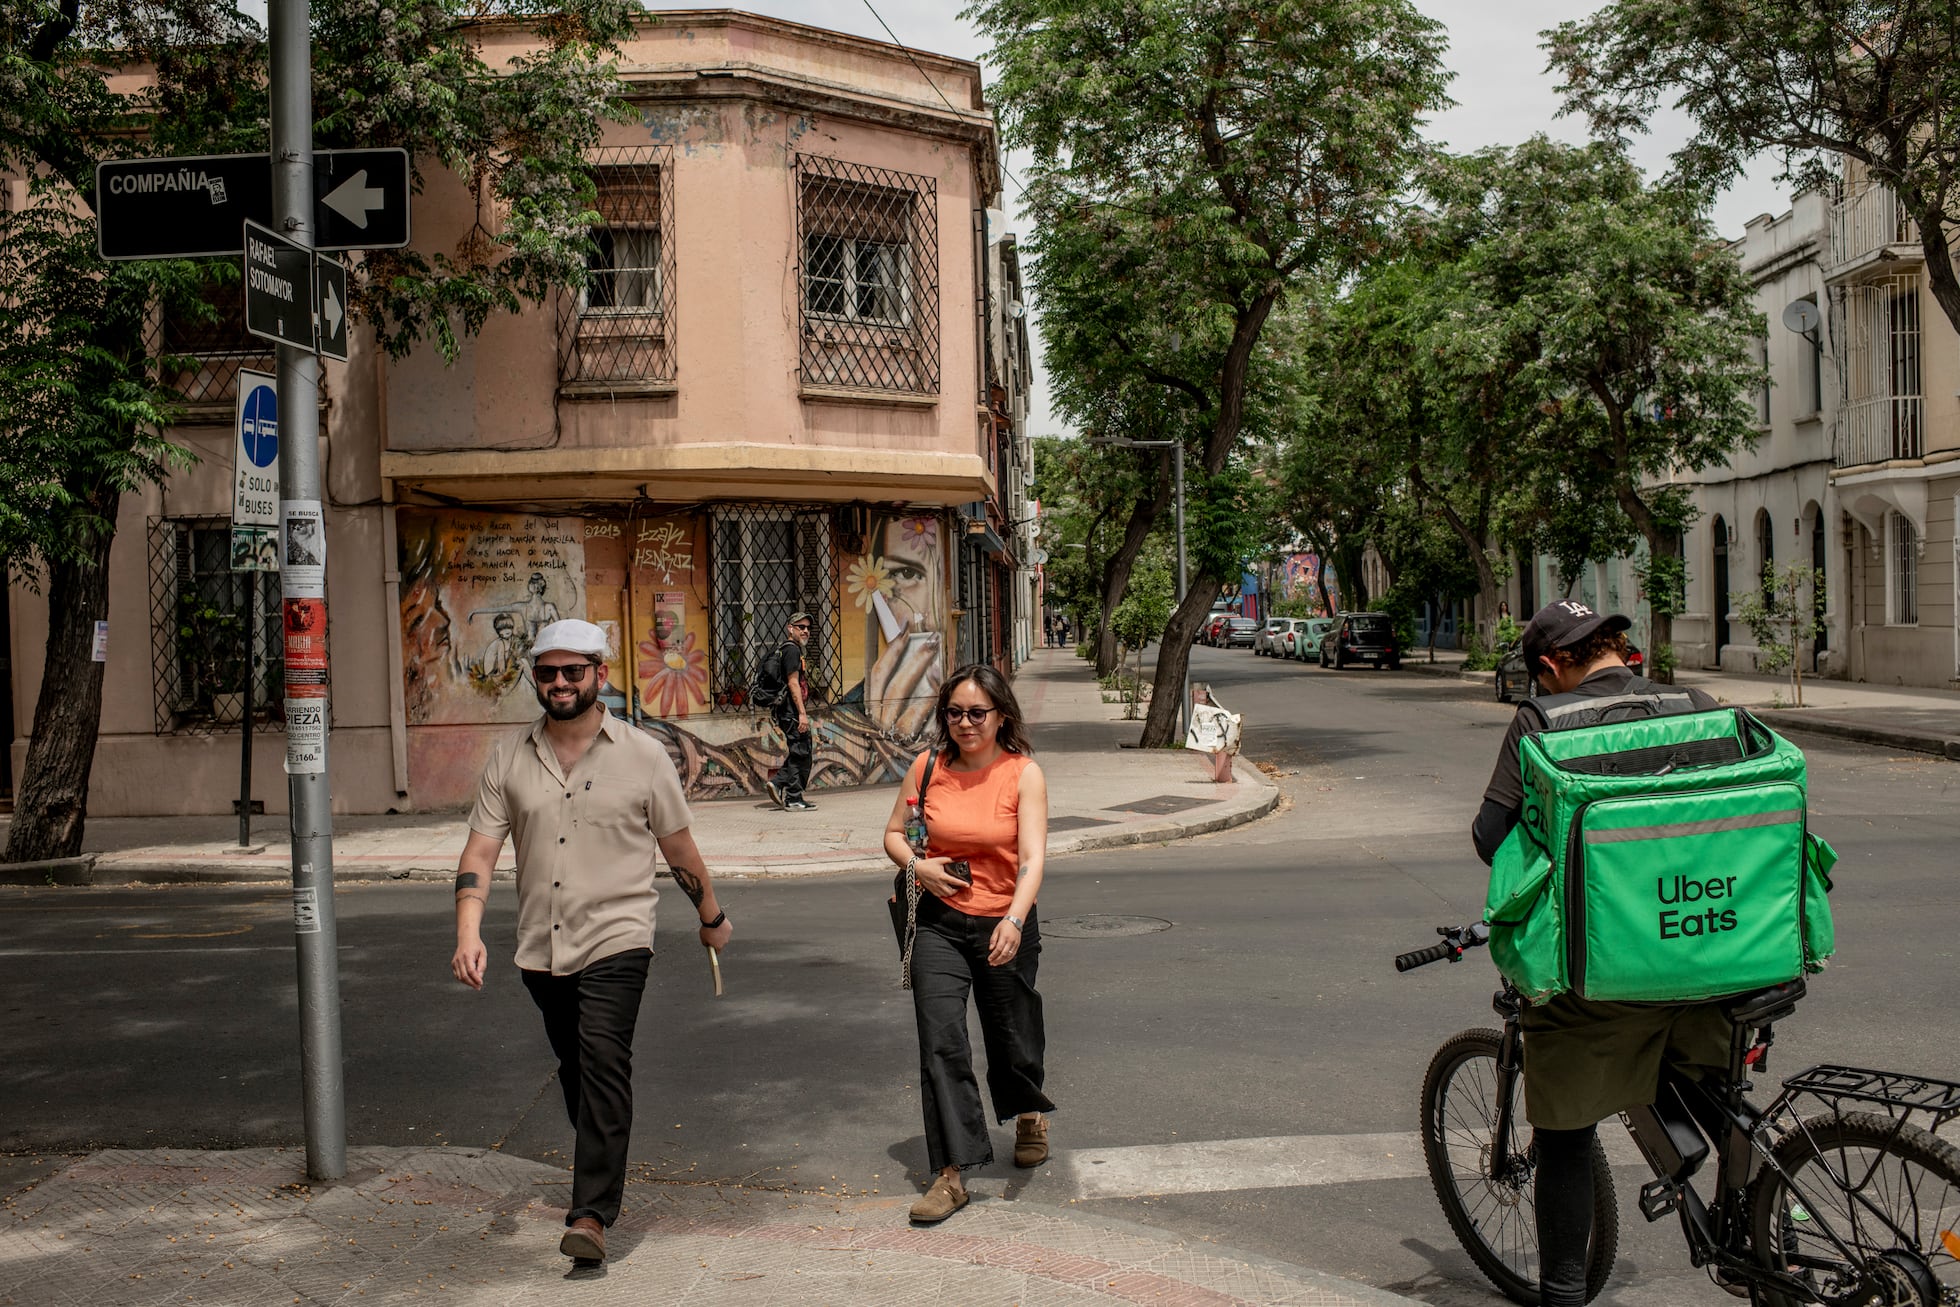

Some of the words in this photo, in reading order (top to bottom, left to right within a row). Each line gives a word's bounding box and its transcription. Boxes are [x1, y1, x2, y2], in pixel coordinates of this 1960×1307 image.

[110, 168, 209, 194] COMPAÑIA
[249, 237, 277, 269] RAFAEL
[250, 266, 294, 303] SOTOMAYOR
[249, 477, 272, 493] SOLO
[245, 500, 273, 515] BUSES
[656, 593, 665, 603] IX
[1558, 601, 1593, 617] LA
[1657, 875, 1737, 905] Uber
[1659, 907, 1738, 940] Eats
